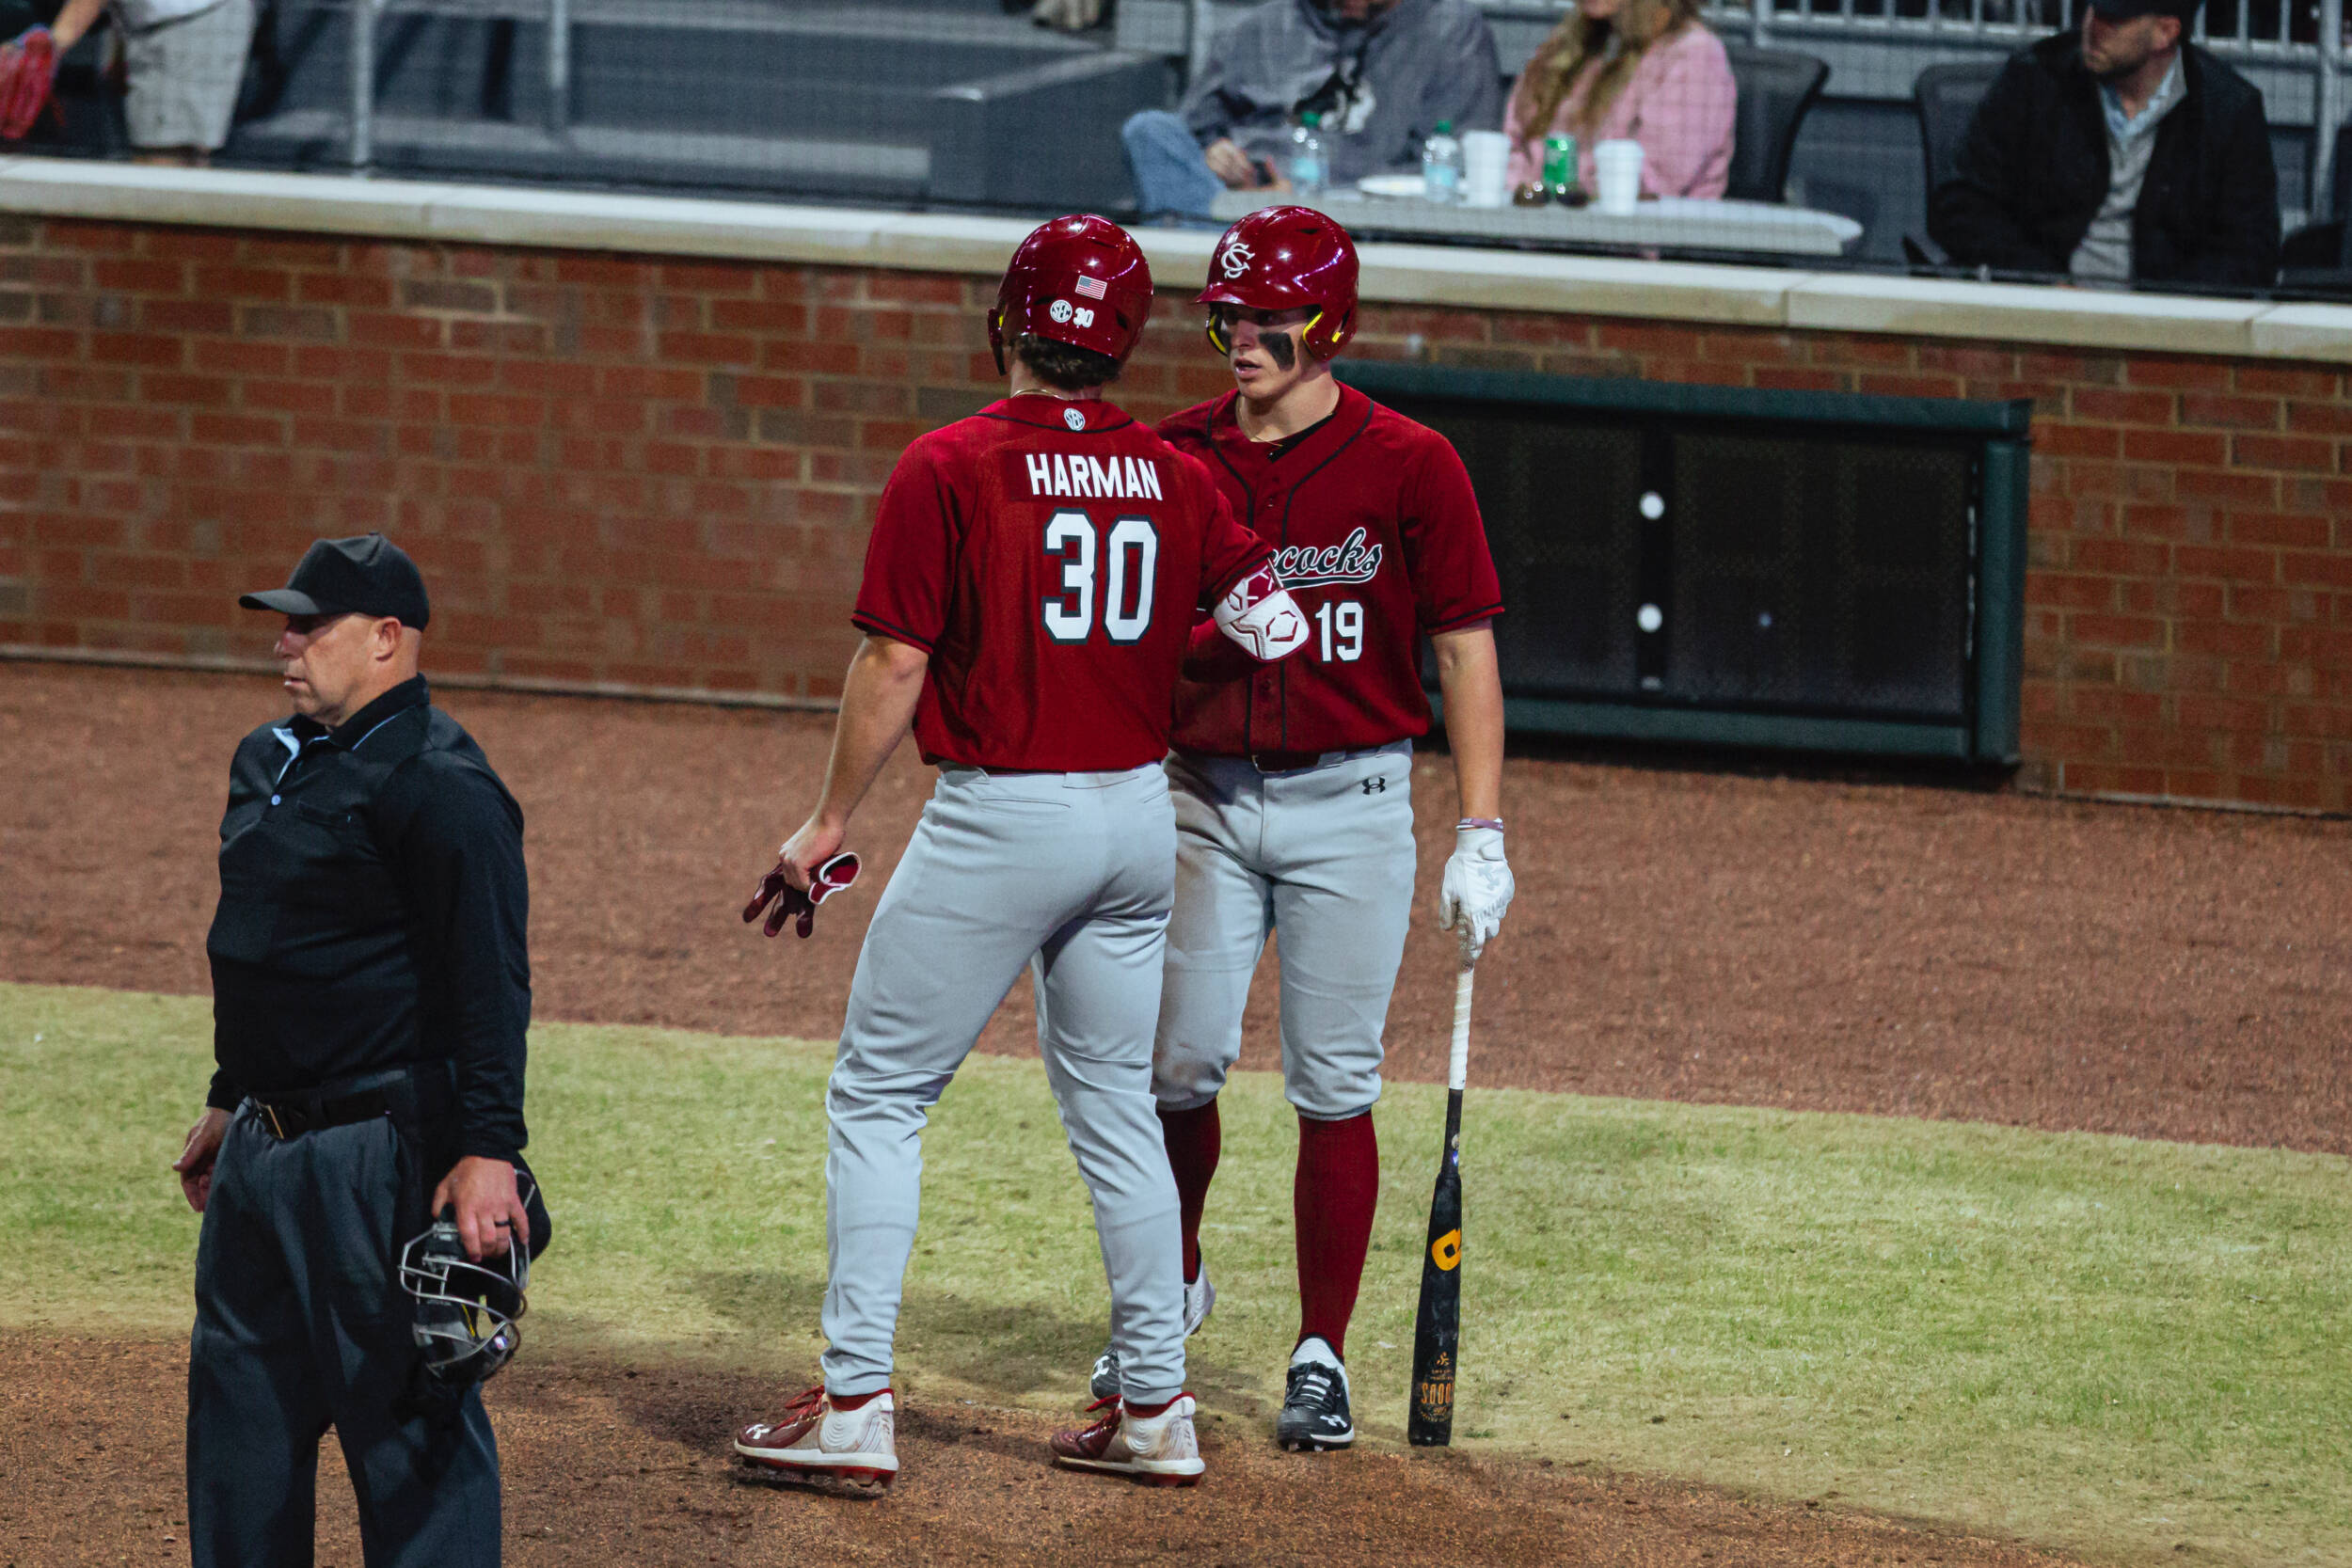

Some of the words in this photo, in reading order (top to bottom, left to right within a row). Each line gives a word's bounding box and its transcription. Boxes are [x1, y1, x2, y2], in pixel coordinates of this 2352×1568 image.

[1073, 307, 1094, 328] 30
[1025, 453, 1163, 501] HARMAN
[1041, 507, 1160, 646] 30
[1270, 527, 1383, 577] cocks
[1315, 599, 1364, 663] 19
[1421, 1382, 1454, 1404] OODS
